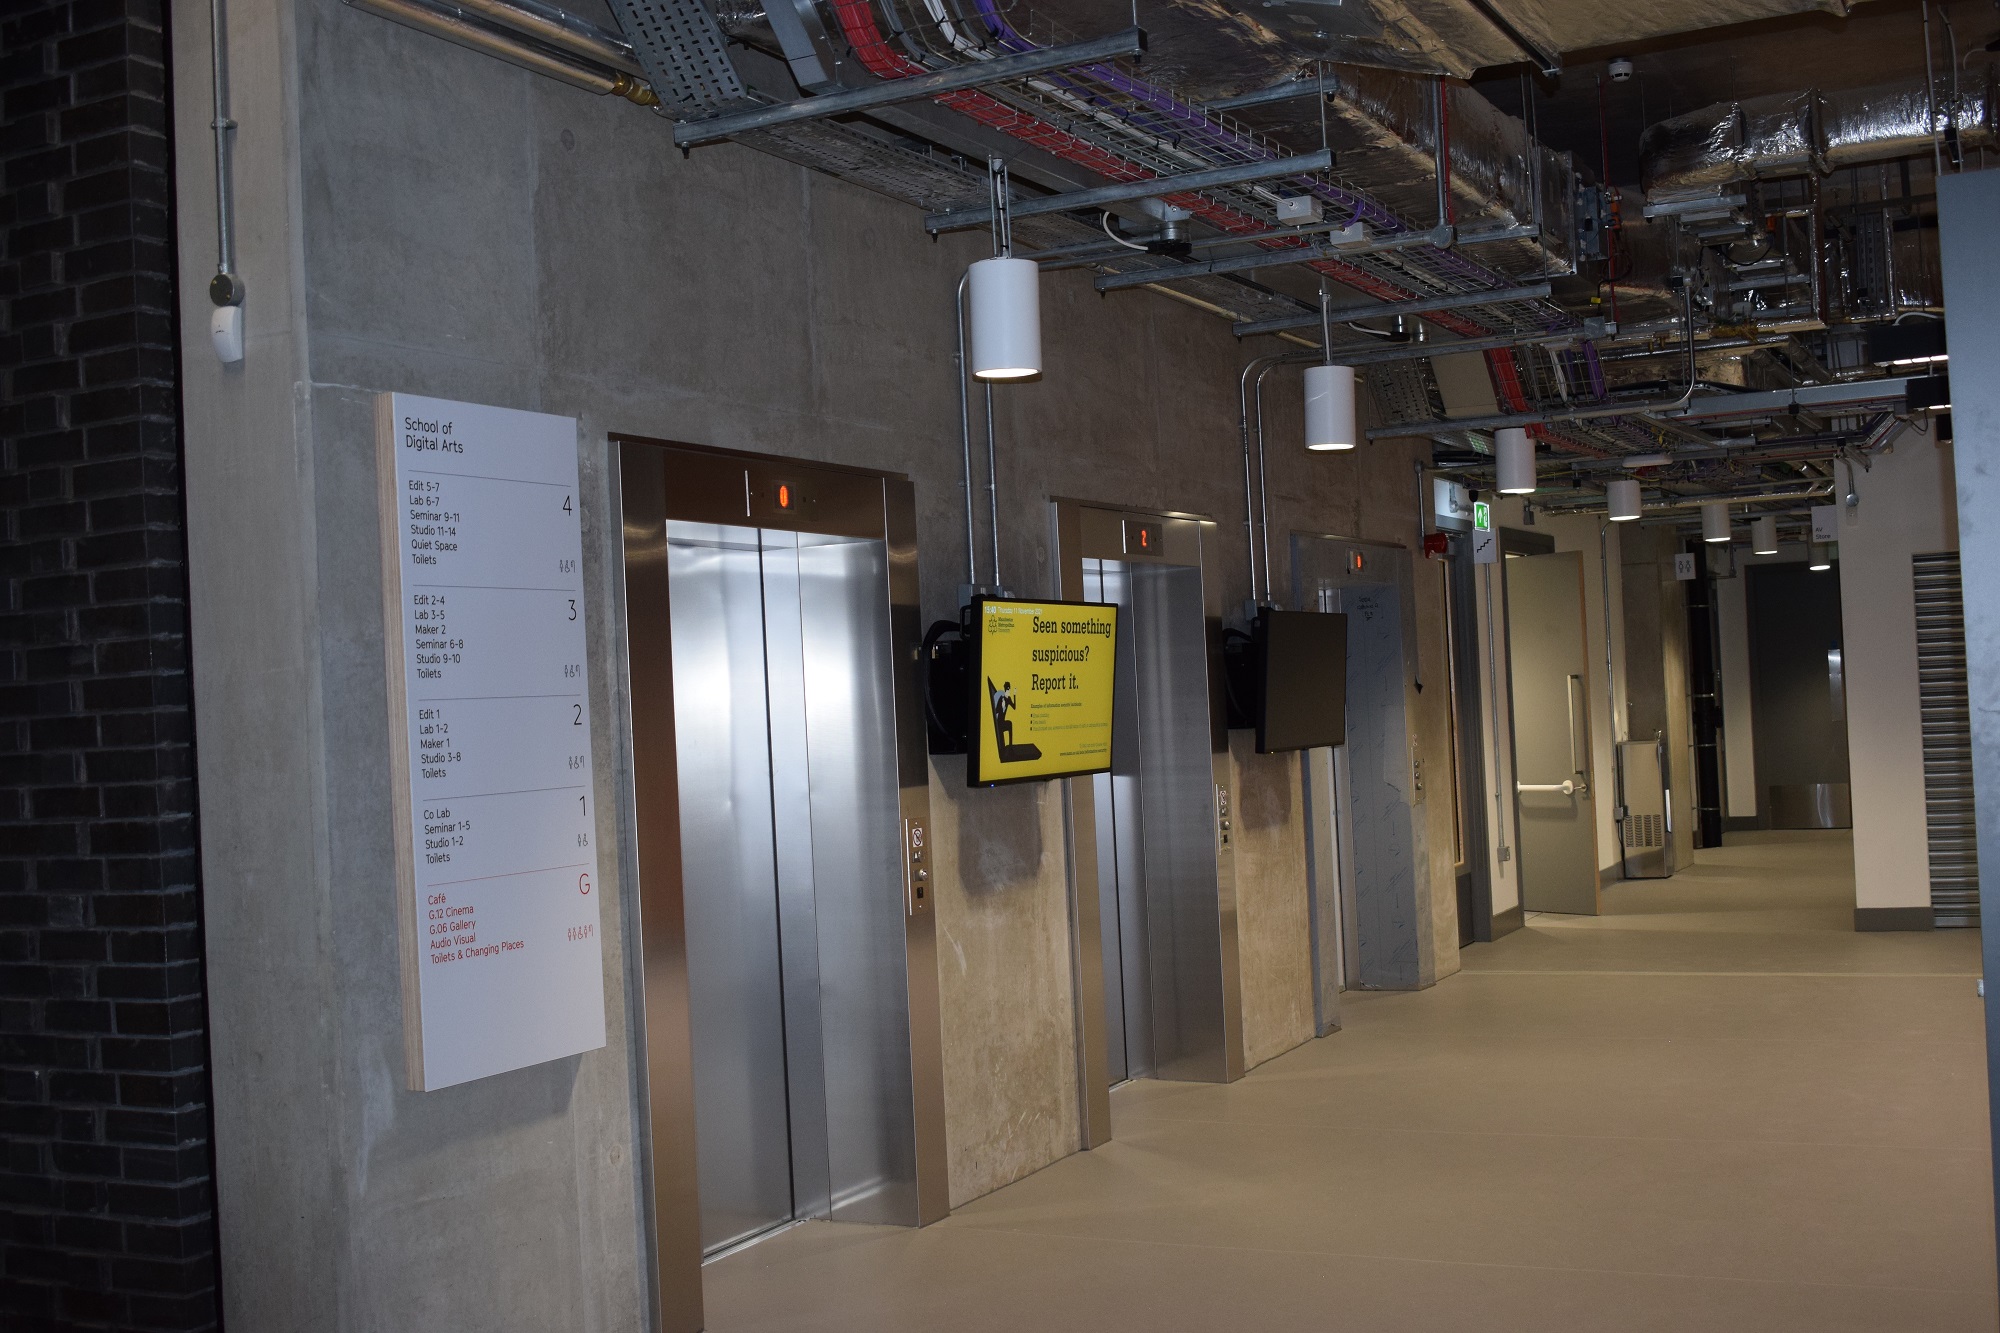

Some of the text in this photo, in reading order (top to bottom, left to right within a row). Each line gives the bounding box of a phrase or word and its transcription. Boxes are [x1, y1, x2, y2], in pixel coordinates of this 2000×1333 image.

[405, 417, 452, 434] School of
[406, 435, 463, 453] Digital Arts
[409, 480, 439, 492] Edit 5-7
[410, 495, 439, 506] Lab 6-7
[562, 495, 572, 517] 4
[410, 510, 459, 522] Seminar 9-11
[411, 524, 456, 536] Studio 11-14
[412, 539, 457, 552] Quiet Space
[412, 554, 436, 564] Toilets
[414, 595, 445, 605] Edit 2-4
[415, 609, 445, 620] Lab 3-5
[568, 600, 577, 621] 3
[416, 624, 446, 634] Maker 2
[1033, 616, 1111, 638] Seen something
[416, 639, 463, 649] Seminar 6-8
[417, 654, 460, 664] Studio 9-10
[1032, 645, 1089, 665] suspicious?
[417, 668, 441, 678] Toilets
[1031, 673, 1079, 694] Report it.
[419, 709, 439, 719] Edit 1
[573, 704, 582, 726] 2
[420, 724, 448, 734] Lab 1-2
[421, 738, 449, 749] Maker 1
[421, 752, 461, 764] Studio 3-8
[422, 768, 446, 778] Toilets
[579, 796, 586, 817] 1
[424, 808, 450, 819] Co Lab
[425, 821, 470, 834] Seminar 1-5
[426, 836, 463, 849] Studio 1-2
[426, 853, 450, 864] Toilets
[579, 873, 591, 896] G
[428, 893, 446, 905] Café
[429, 906, 473, 919] G.12 Cinema
[430, 920, 476, 934] G.06 Gallery
[431, 932, 476, 949] Audio Visual
[431, 941, 524, 964] Toilets & Changing Places
